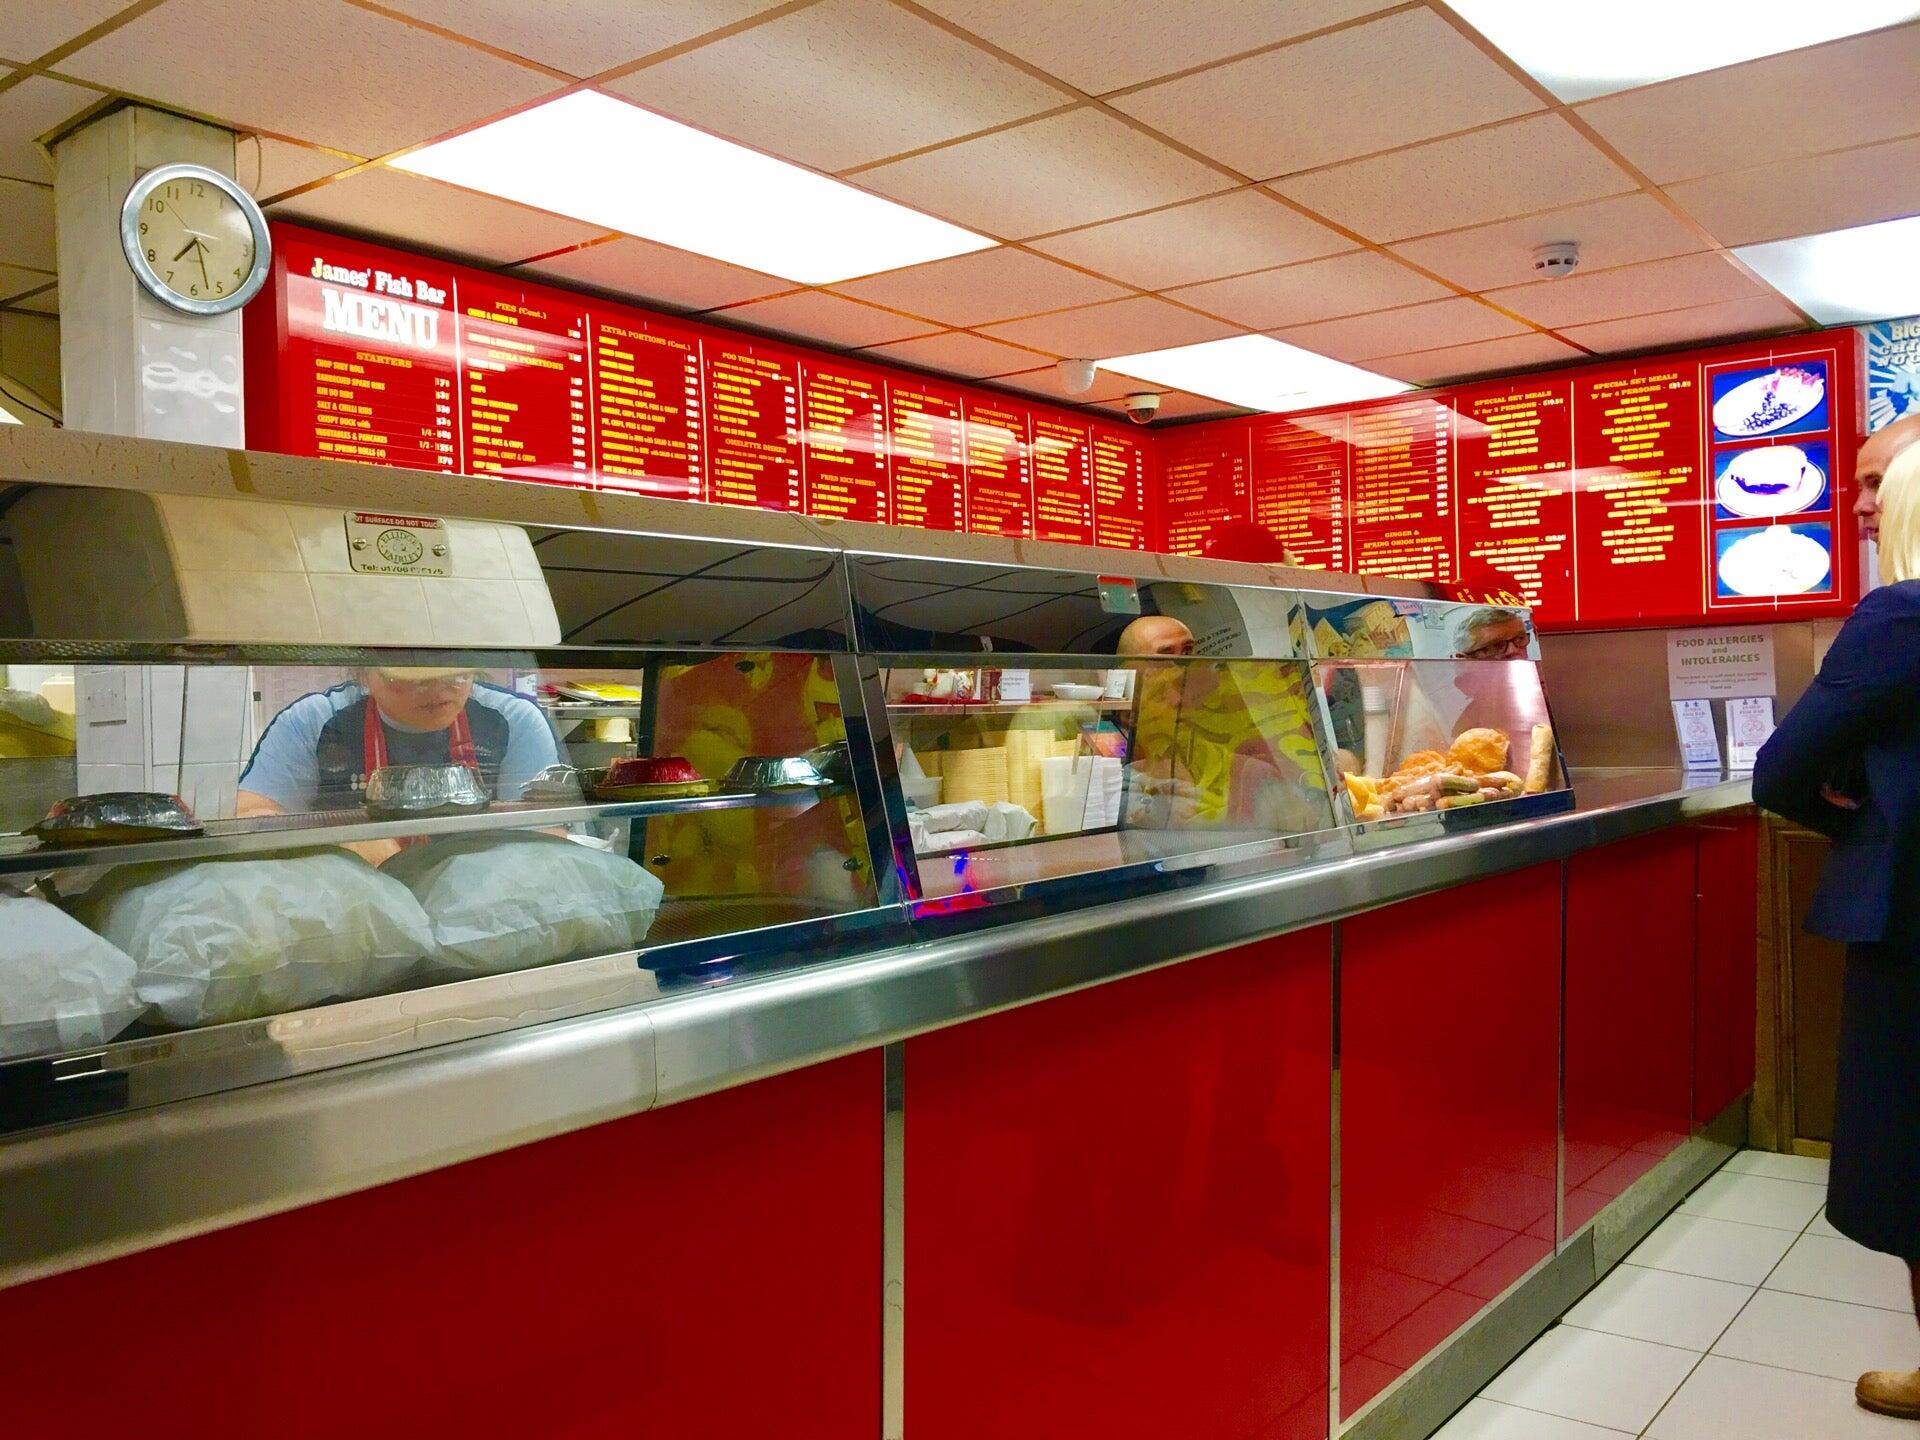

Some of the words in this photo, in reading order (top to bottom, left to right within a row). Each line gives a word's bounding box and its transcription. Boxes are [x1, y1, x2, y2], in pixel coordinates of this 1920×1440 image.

[166, 186, 180, 201] 11
[189, 183, 205, 199] 12
[149, 198, 165, 214] 10
[139, 222, 149, 236] 9
[147, 249, 157, 262] 8
[166, 270, 175, 284] 7
[233, 267, 241, 280] 4
[215, 281, 224, 294] 5
[311, 257, 371, 288] James'
[375, 270, 413, 298] Fish
[416, 280, 447, 305] Bar
[190, 284, 199, 296] 6
[495, 302, 517, 313] PIES
[321, 288, 440, 350] MENU
[600, 324, 628, 337] EXTRA
[628, 330, 667, 346] PORTIONS
[356, 351, 413, 368] STARTERS
[522, 355, 565, 371] PORTIONS
[1593, 379, 1629, 391] SPECIAL
[1629, 377, 1647, 385] SET
[1648, 372, 1679, 383] MEALS
[1620, 384, 1662, 396] PERSONS
[1473, 396, 1507, 407] SPECIAL
[1507, 394, 1524, 402] SET
[1524, 390, 1552, 400] MEALS
[317, 400, 331, 410] SALT
[332, 402, 338, 411] &
[1500, 401, 1537, 412] PERSONS
[352, 431, 358, 441] &
[724, 437, 762, 451] OMELETTE
[1500, 464, 1538, 475] PERSONS
[365, 516, 396, 525] SURFACE
[396, 518, 406, 526] DO
[406, 519, 420, 527] NOT
[420, 520, 438, 528] TOUC
[1384, 530, 1413, 538] GINGER
[1363, 540, 1390, 549] SPRING
[1390, 538, 1415, 546] ONION
[1502, 536, 1540, 546] PERSONS
[360, 563, 379, 571] Tel:
[1676, 638, 1705, 648] FOOD
[1706, 633, 1765, 646] ALLERGIES
[1711, 646, 1728, 654] and
[1681, 653, 1761, 666] INTOLERANCES
